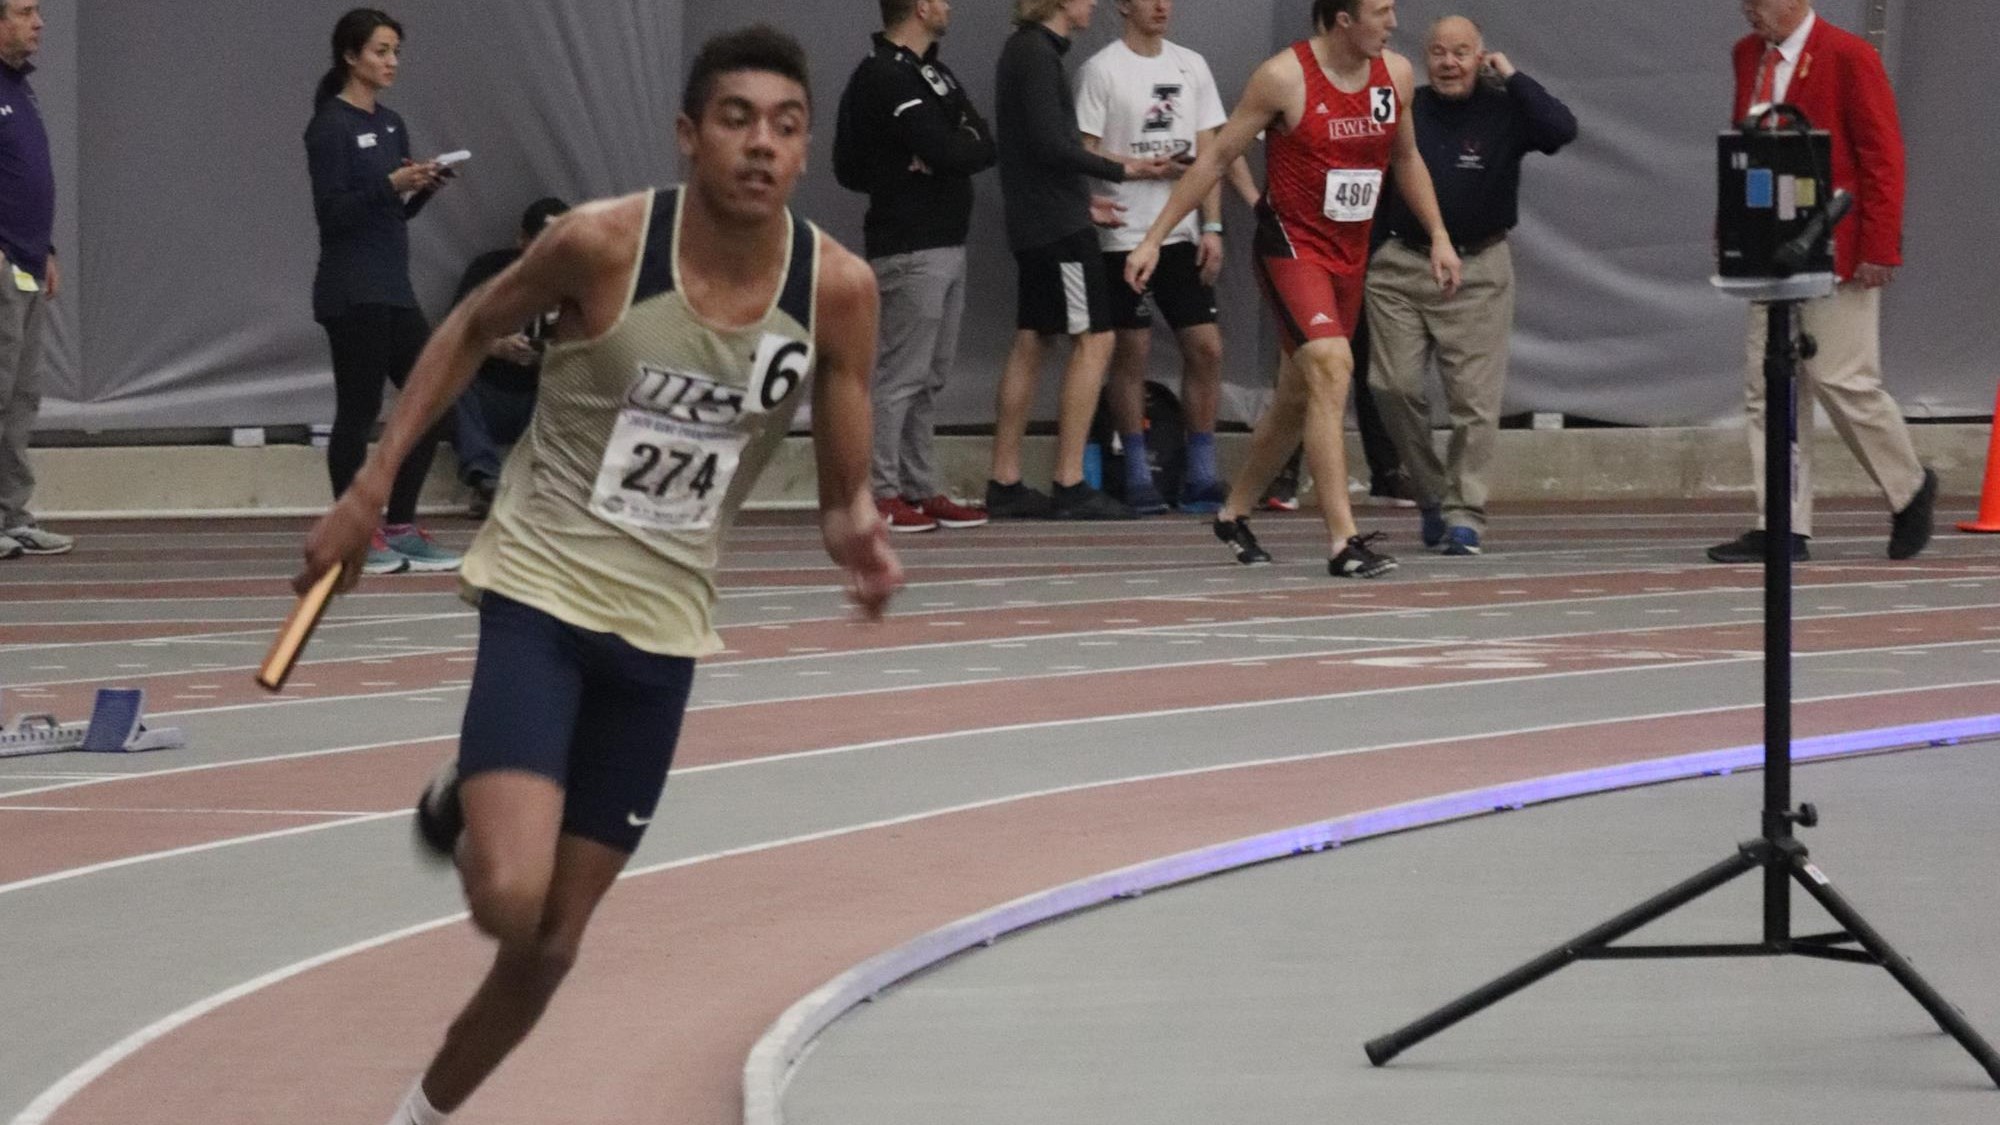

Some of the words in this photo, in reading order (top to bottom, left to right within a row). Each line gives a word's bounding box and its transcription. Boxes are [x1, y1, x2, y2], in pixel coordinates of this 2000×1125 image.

[1373, 87, 1392, 122] 3
[1335, 183, 1372, 206] 480
[760, 341, 808, 410] 6
[621, 443, 718, 500] 274
